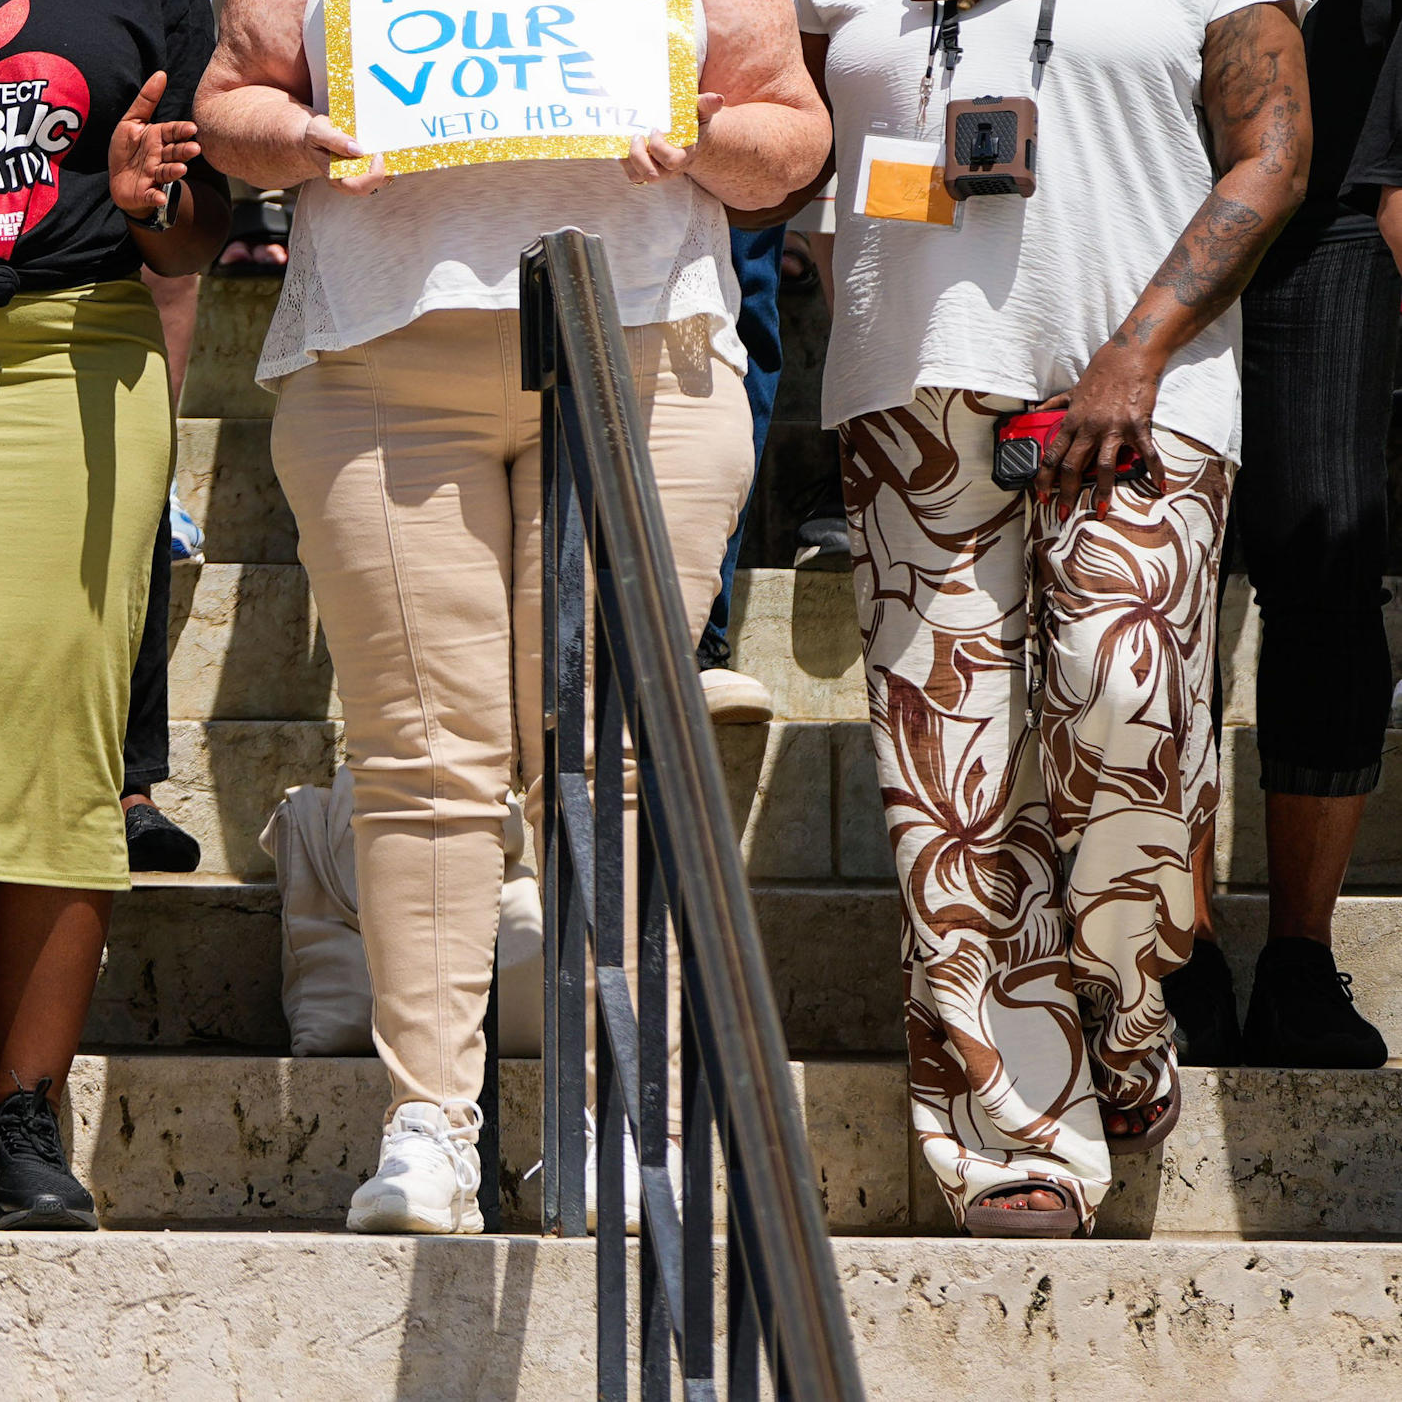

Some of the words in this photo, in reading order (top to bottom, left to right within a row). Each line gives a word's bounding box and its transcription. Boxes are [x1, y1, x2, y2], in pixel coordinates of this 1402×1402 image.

[387, 4, 579, 55] OUR
[368, 51, 610, 106] VOTE
[421, 109, 499, 138] VETO
[524, 104, 574, 131] HB
[585, 105, 647, 130] 472
